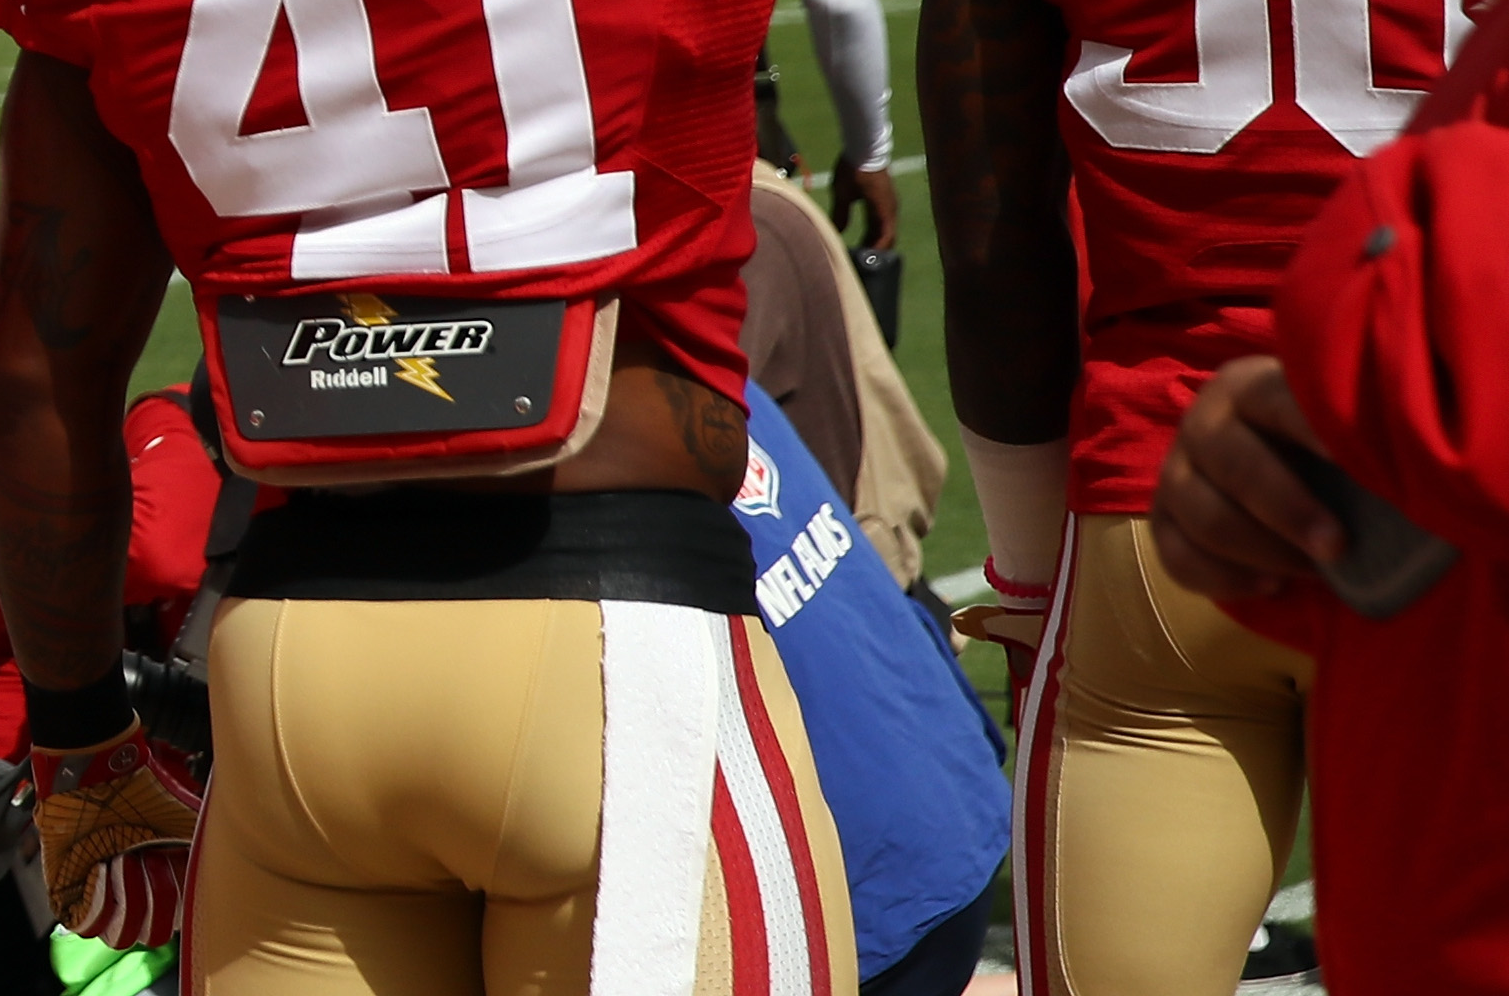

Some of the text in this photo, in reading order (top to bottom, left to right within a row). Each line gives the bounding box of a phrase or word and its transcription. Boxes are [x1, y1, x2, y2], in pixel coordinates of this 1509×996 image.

[282, 317, 493, 366] POWER
[310, 366, 388, 389] Riddell
[755, 553, 816, 628] NFL
